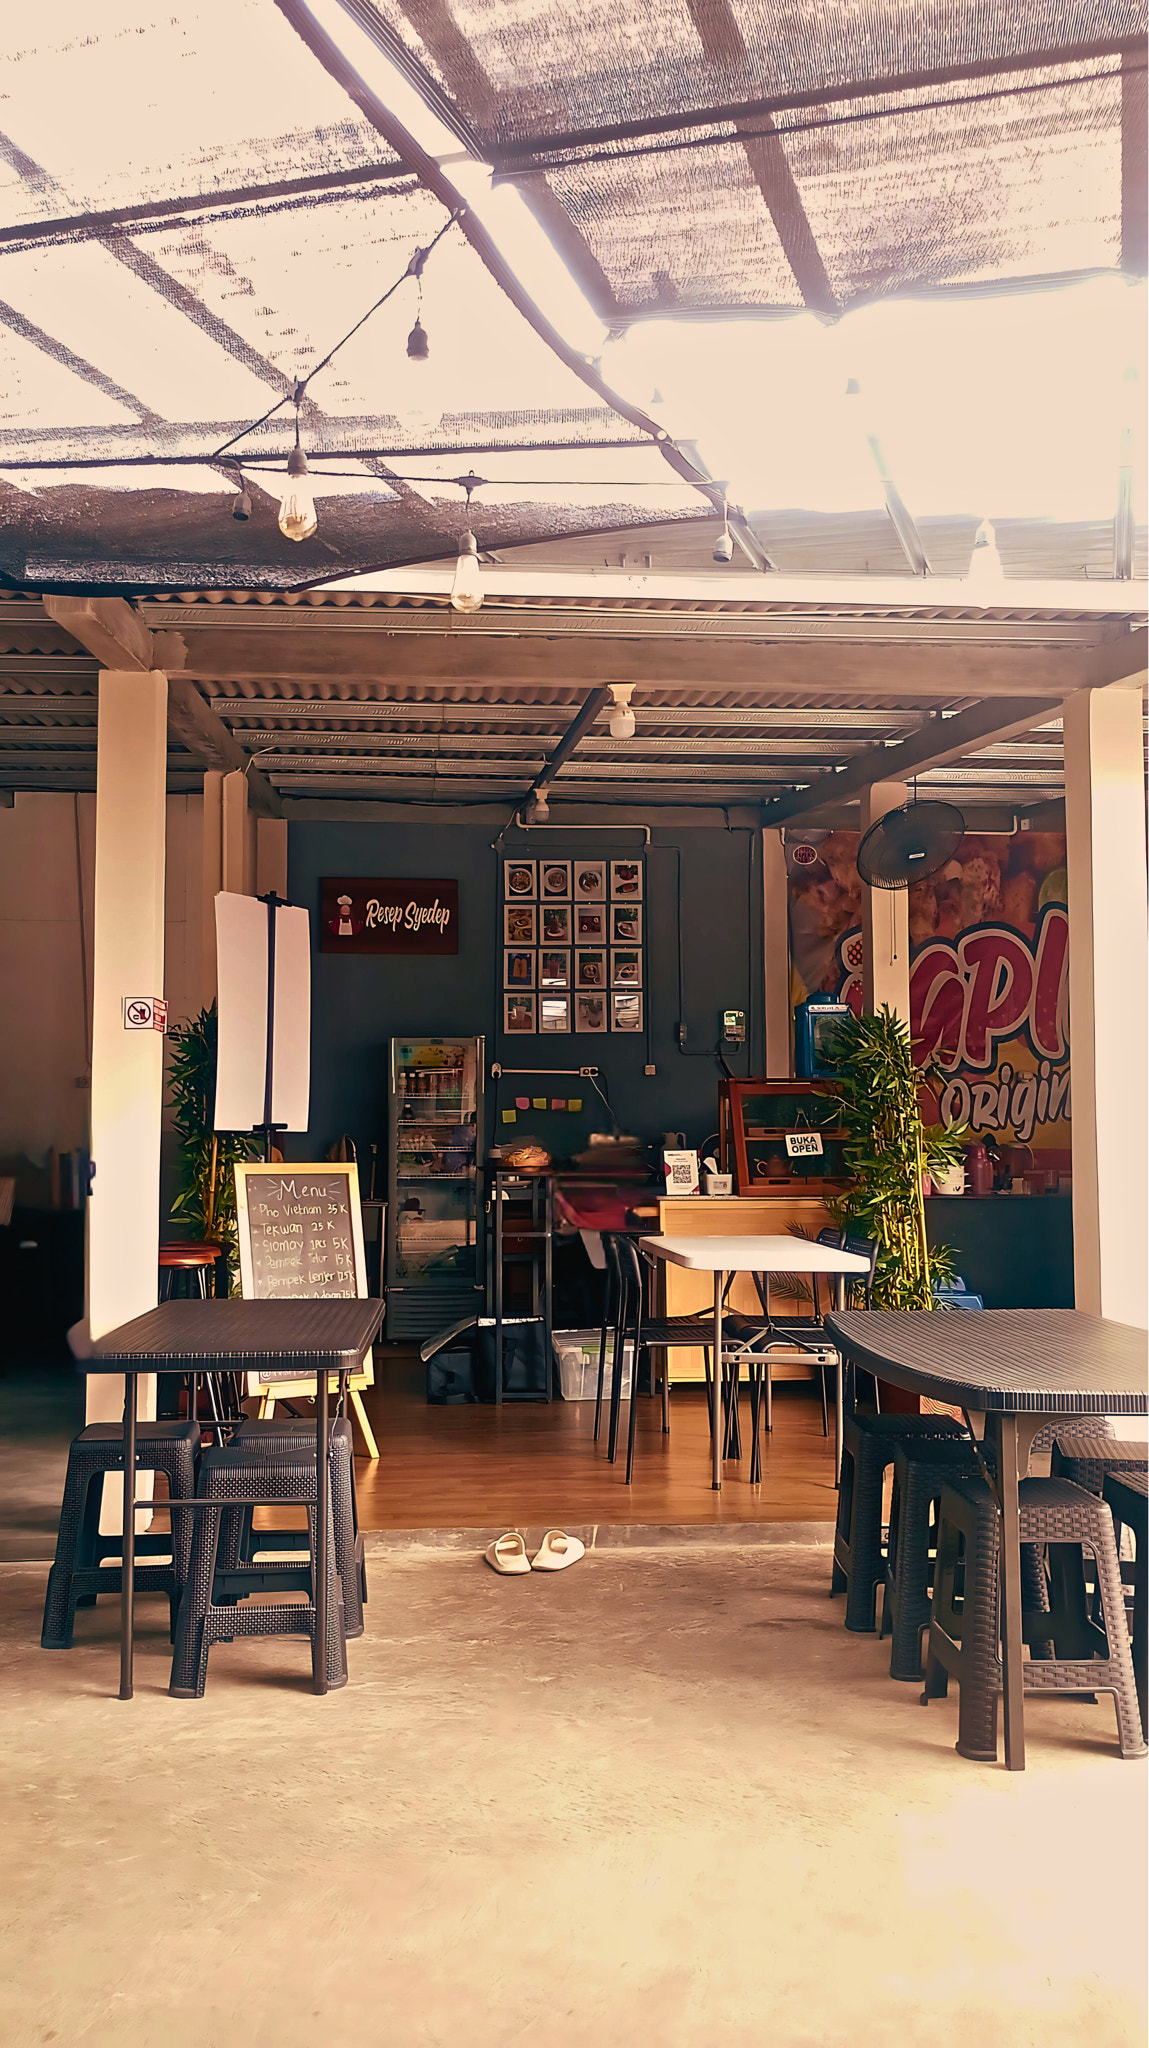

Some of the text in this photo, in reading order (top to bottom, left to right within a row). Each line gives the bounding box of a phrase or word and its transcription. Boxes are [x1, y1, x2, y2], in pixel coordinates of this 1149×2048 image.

[365, 898, 450, 934] Resep Syedep
[790, 1136, 817, 1145] BUKA
[791, 1144, 819, 1153] OPEN
[277, 1179, 327, 1201] Menu
[259, 1203, 280, 1218] Pho
